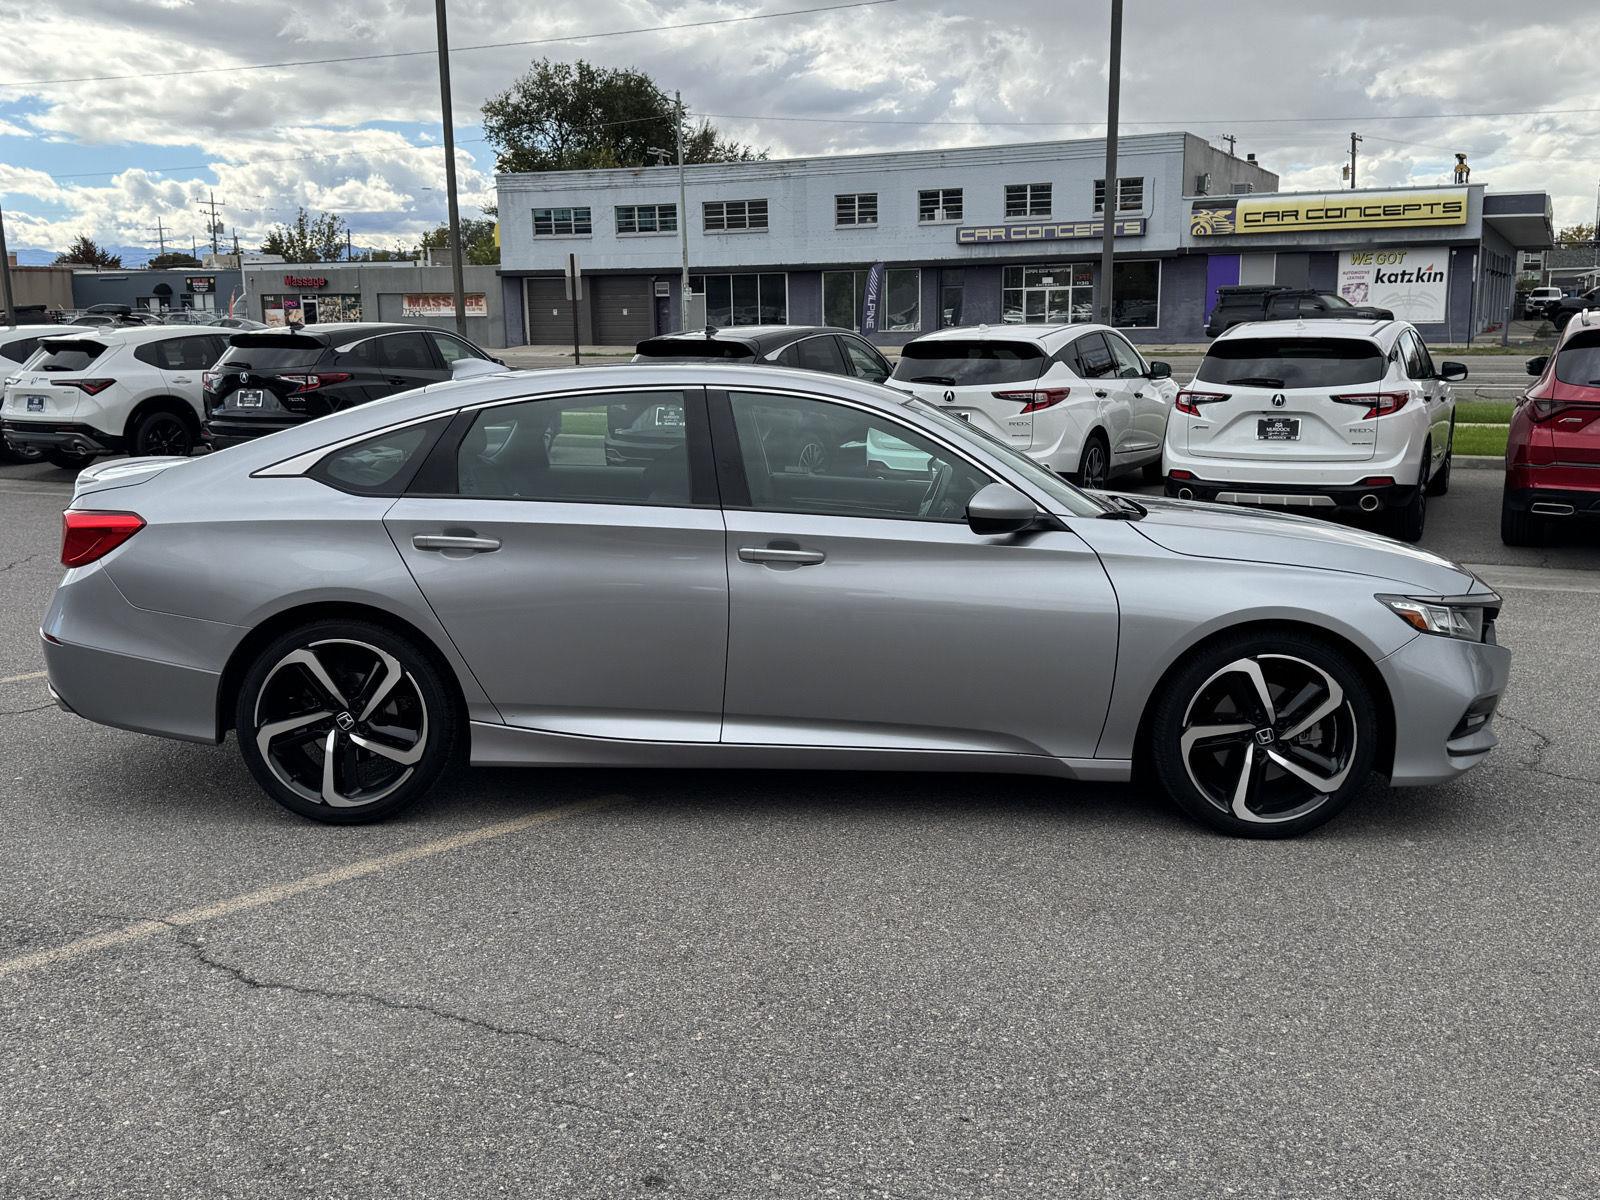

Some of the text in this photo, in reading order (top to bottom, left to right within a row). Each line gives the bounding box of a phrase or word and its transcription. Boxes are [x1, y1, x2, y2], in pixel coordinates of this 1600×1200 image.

[1244, 201, 1462, 223] CAR CONCEPTS
[959, 227, 1006, 241] CAR
[1351, 251, 1407, 265] WE GOT
[1374, 263, 1444, 284] katzkin
[284, 275, 326, 288] Massage
